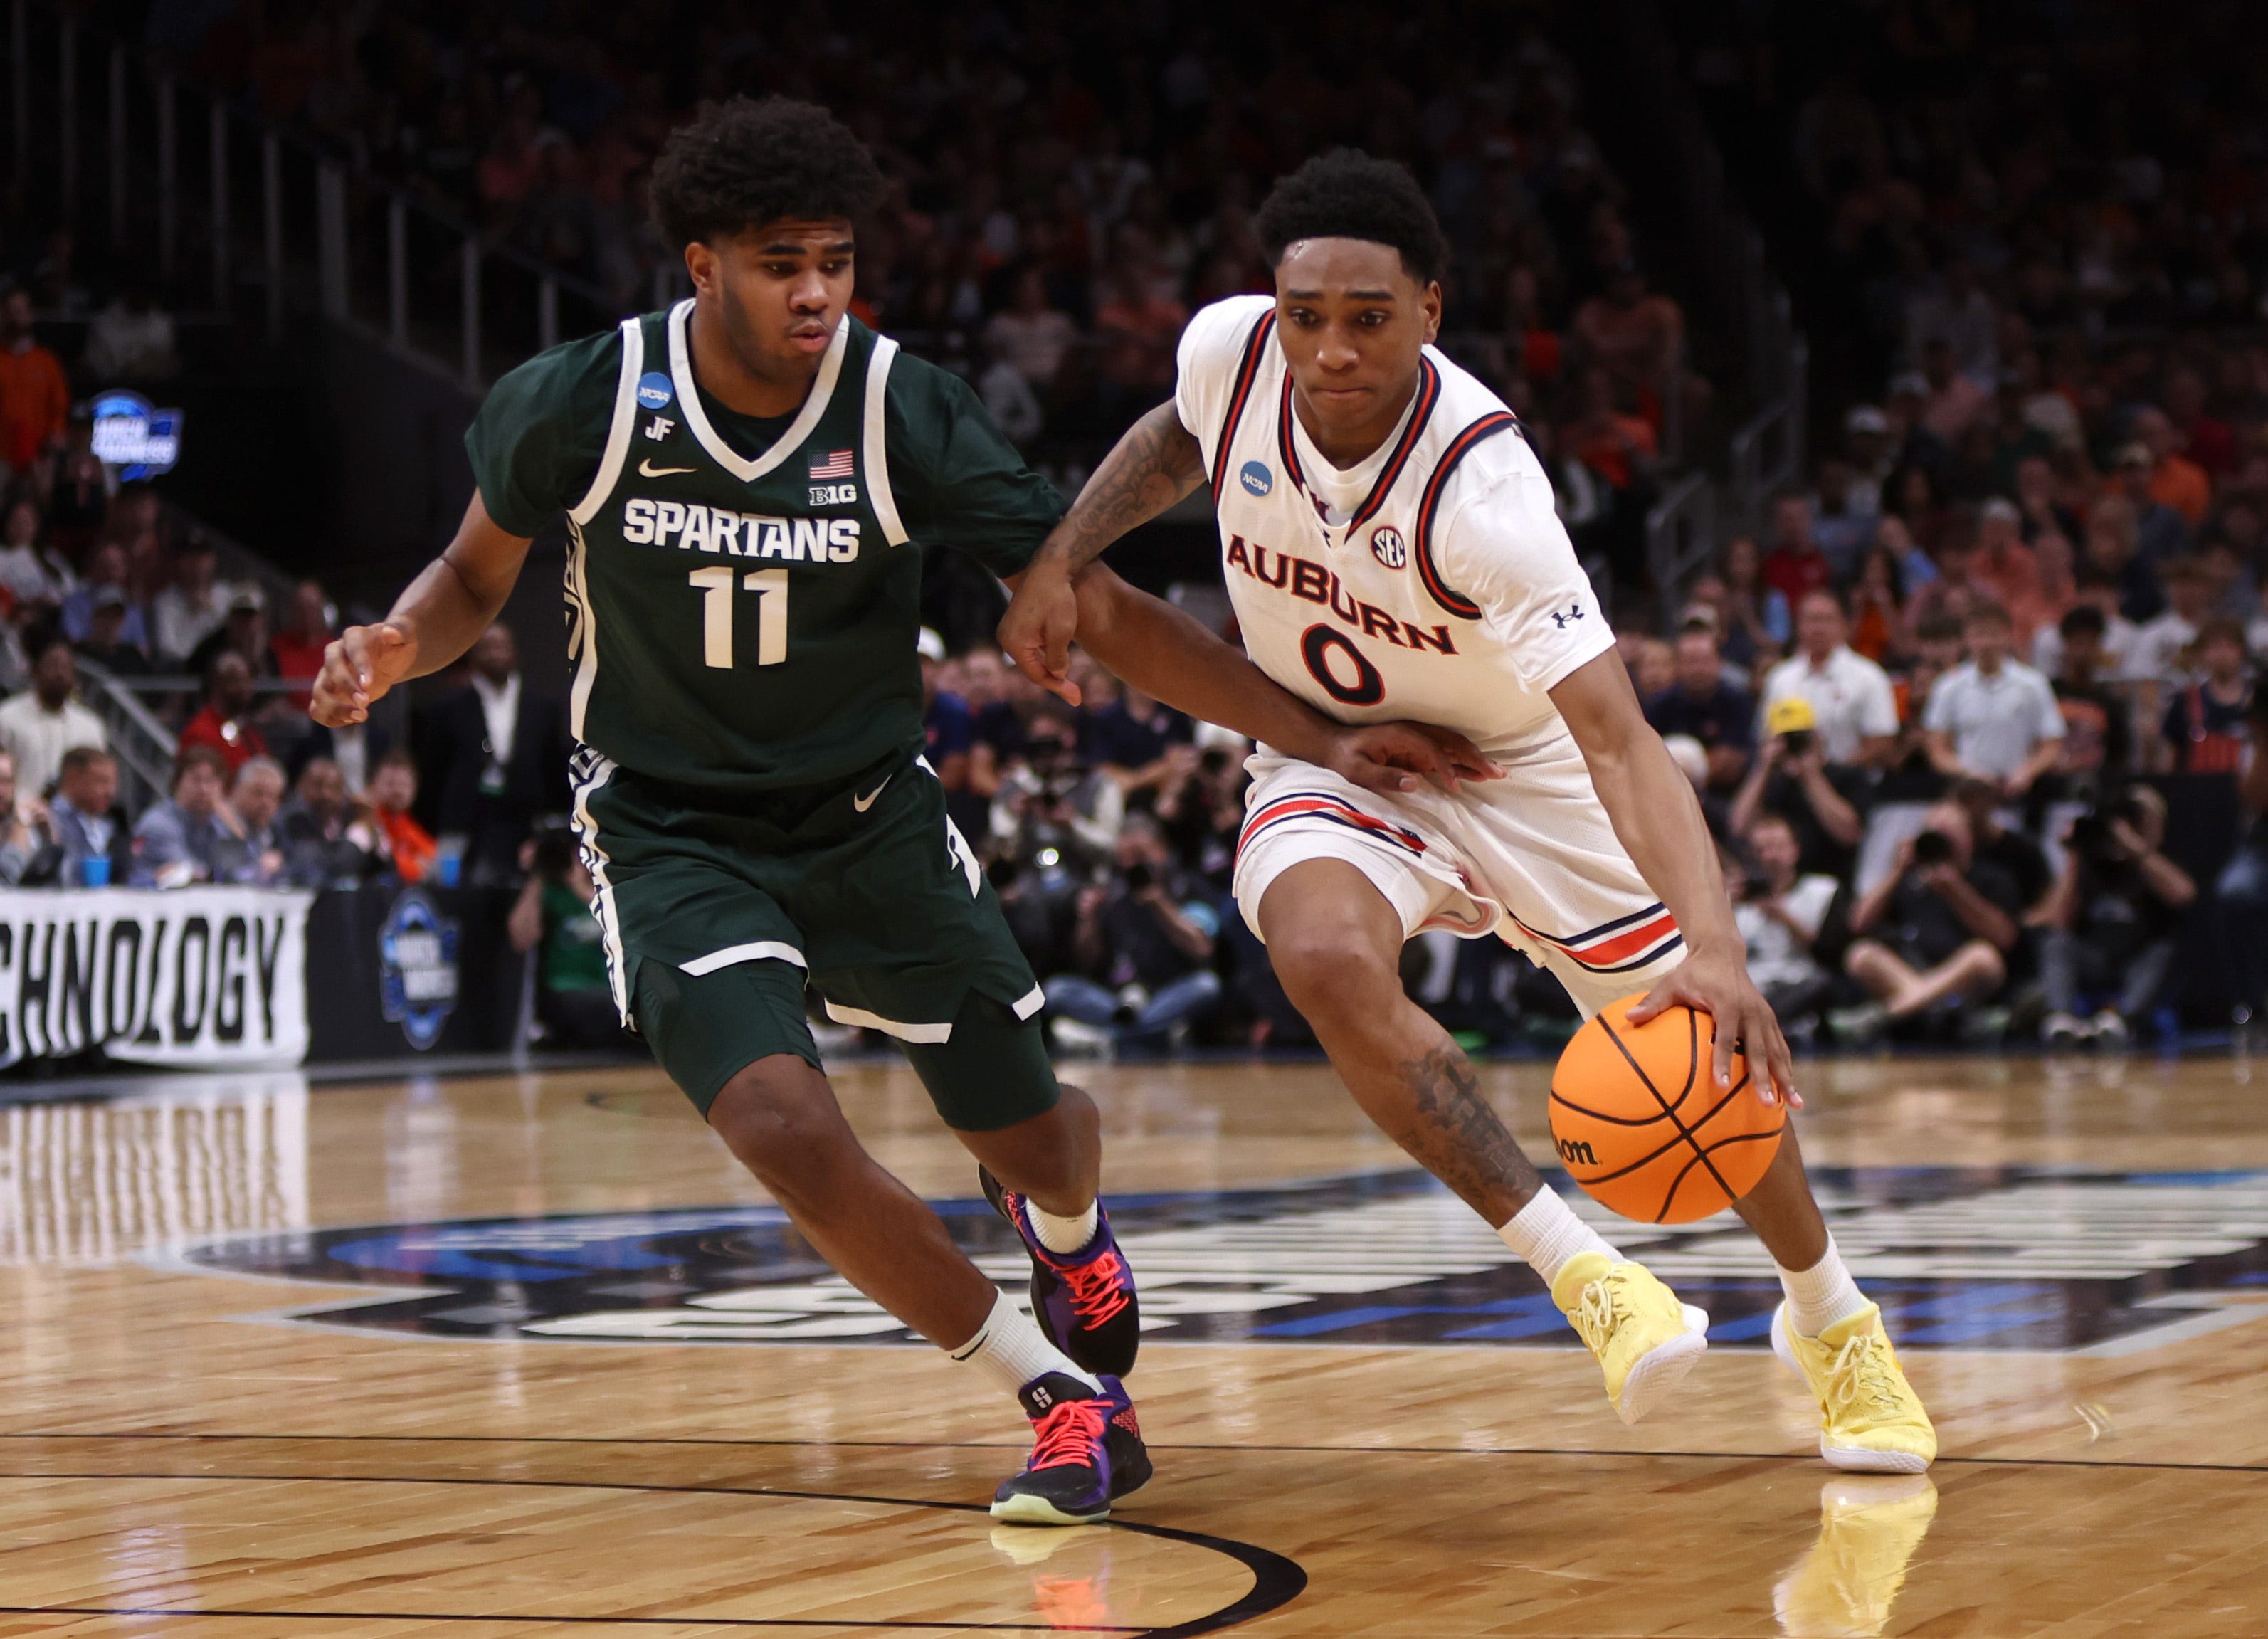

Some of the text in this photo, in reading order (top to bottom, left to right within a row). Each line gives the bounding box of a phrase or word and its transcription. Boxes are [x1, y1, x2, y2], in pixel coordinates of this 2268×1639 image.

[645, 416, 675, 442] JF
[1243, 473, 1268, 494] NCAA
[623, 498, 860, 563] SPARTANS
[1374, 529, 1405, 568] SEC
[689, 566, 788, 669] 11
[1227, 534, 1459, 655] AUBURN
[1300, 623, 1386, 706] 0
